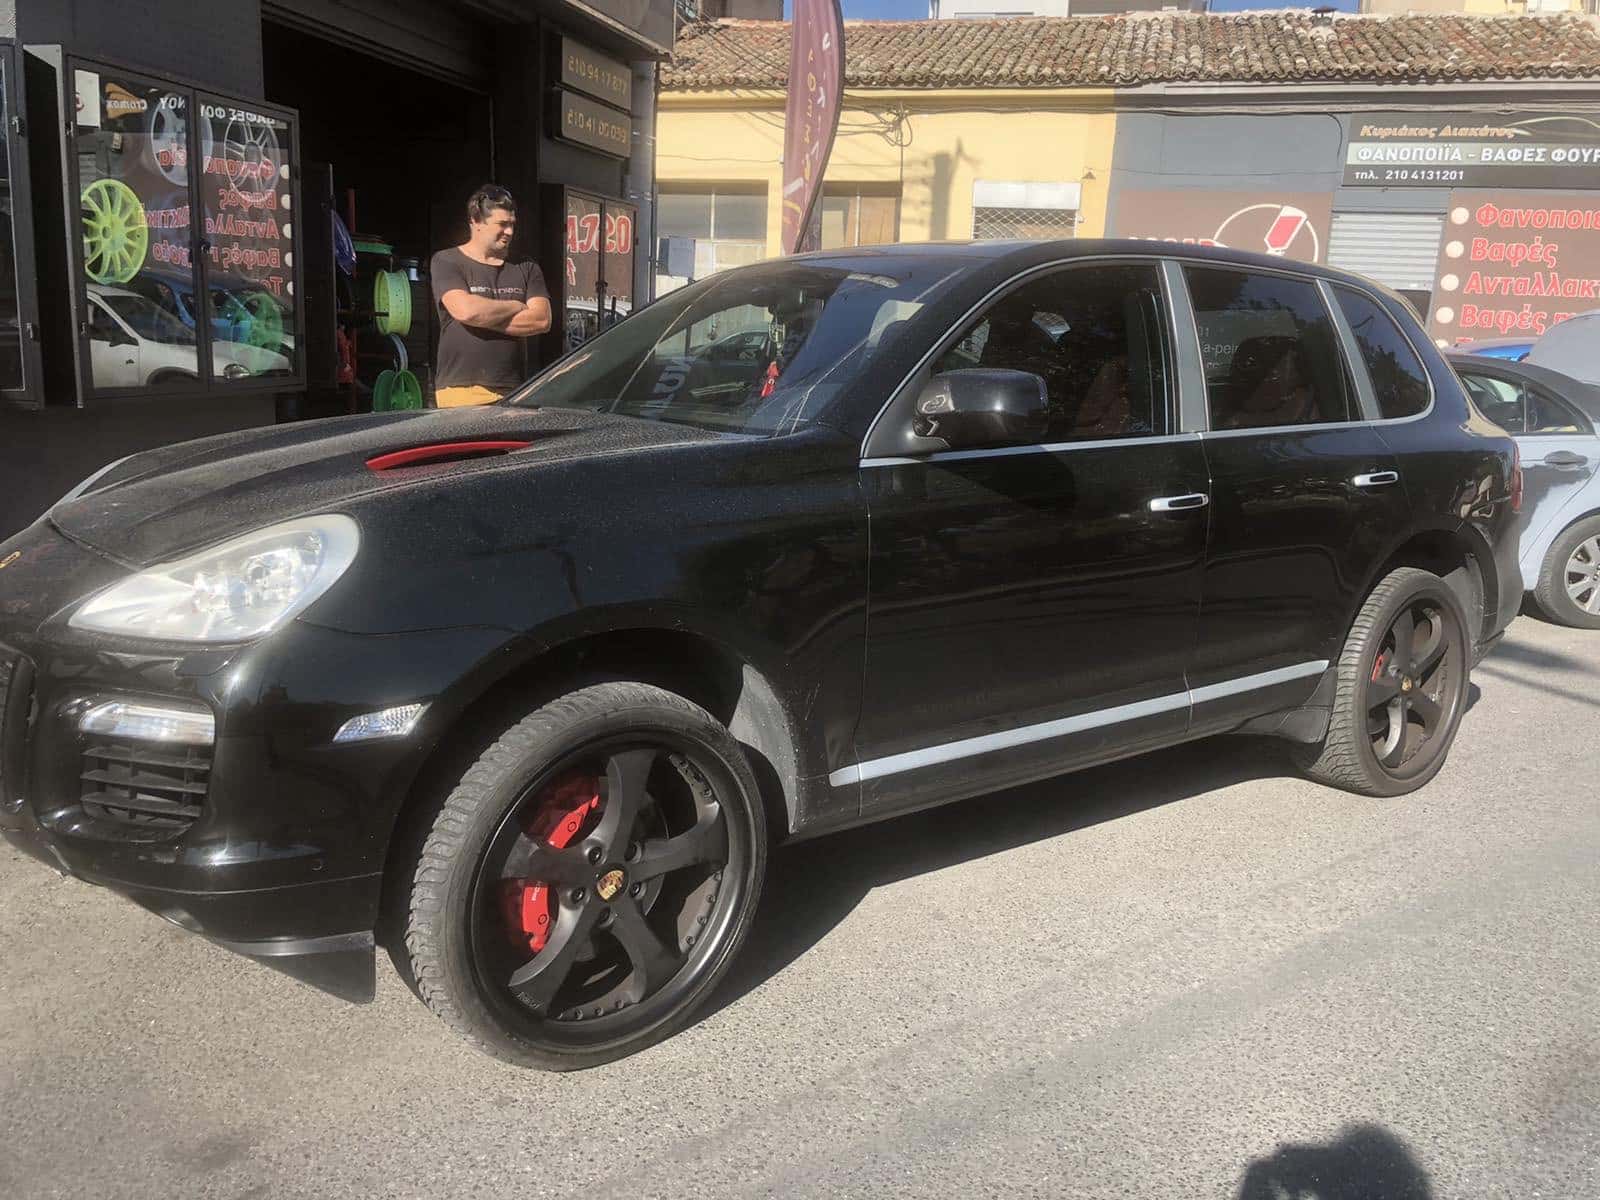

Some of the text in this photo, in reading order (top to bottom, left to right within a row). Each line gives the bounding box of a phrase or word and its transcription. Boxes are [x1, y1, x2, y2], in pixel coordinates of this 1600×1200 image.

[1359, 125, 1438, 139] Κυριάκος
[1358, 143, 1462, 162] ΦΑΝΟΠΟΙΪΑ
[1481, 147, 1547, 162] ΒΑΦΕΣ
[1385, 170, 1408, 180] 210
[1411, 170, 1464, 180] 4131201
[1470, 235, 1559, 268] Βαφές
[1459, 303, 1548, 335] Βαφές
